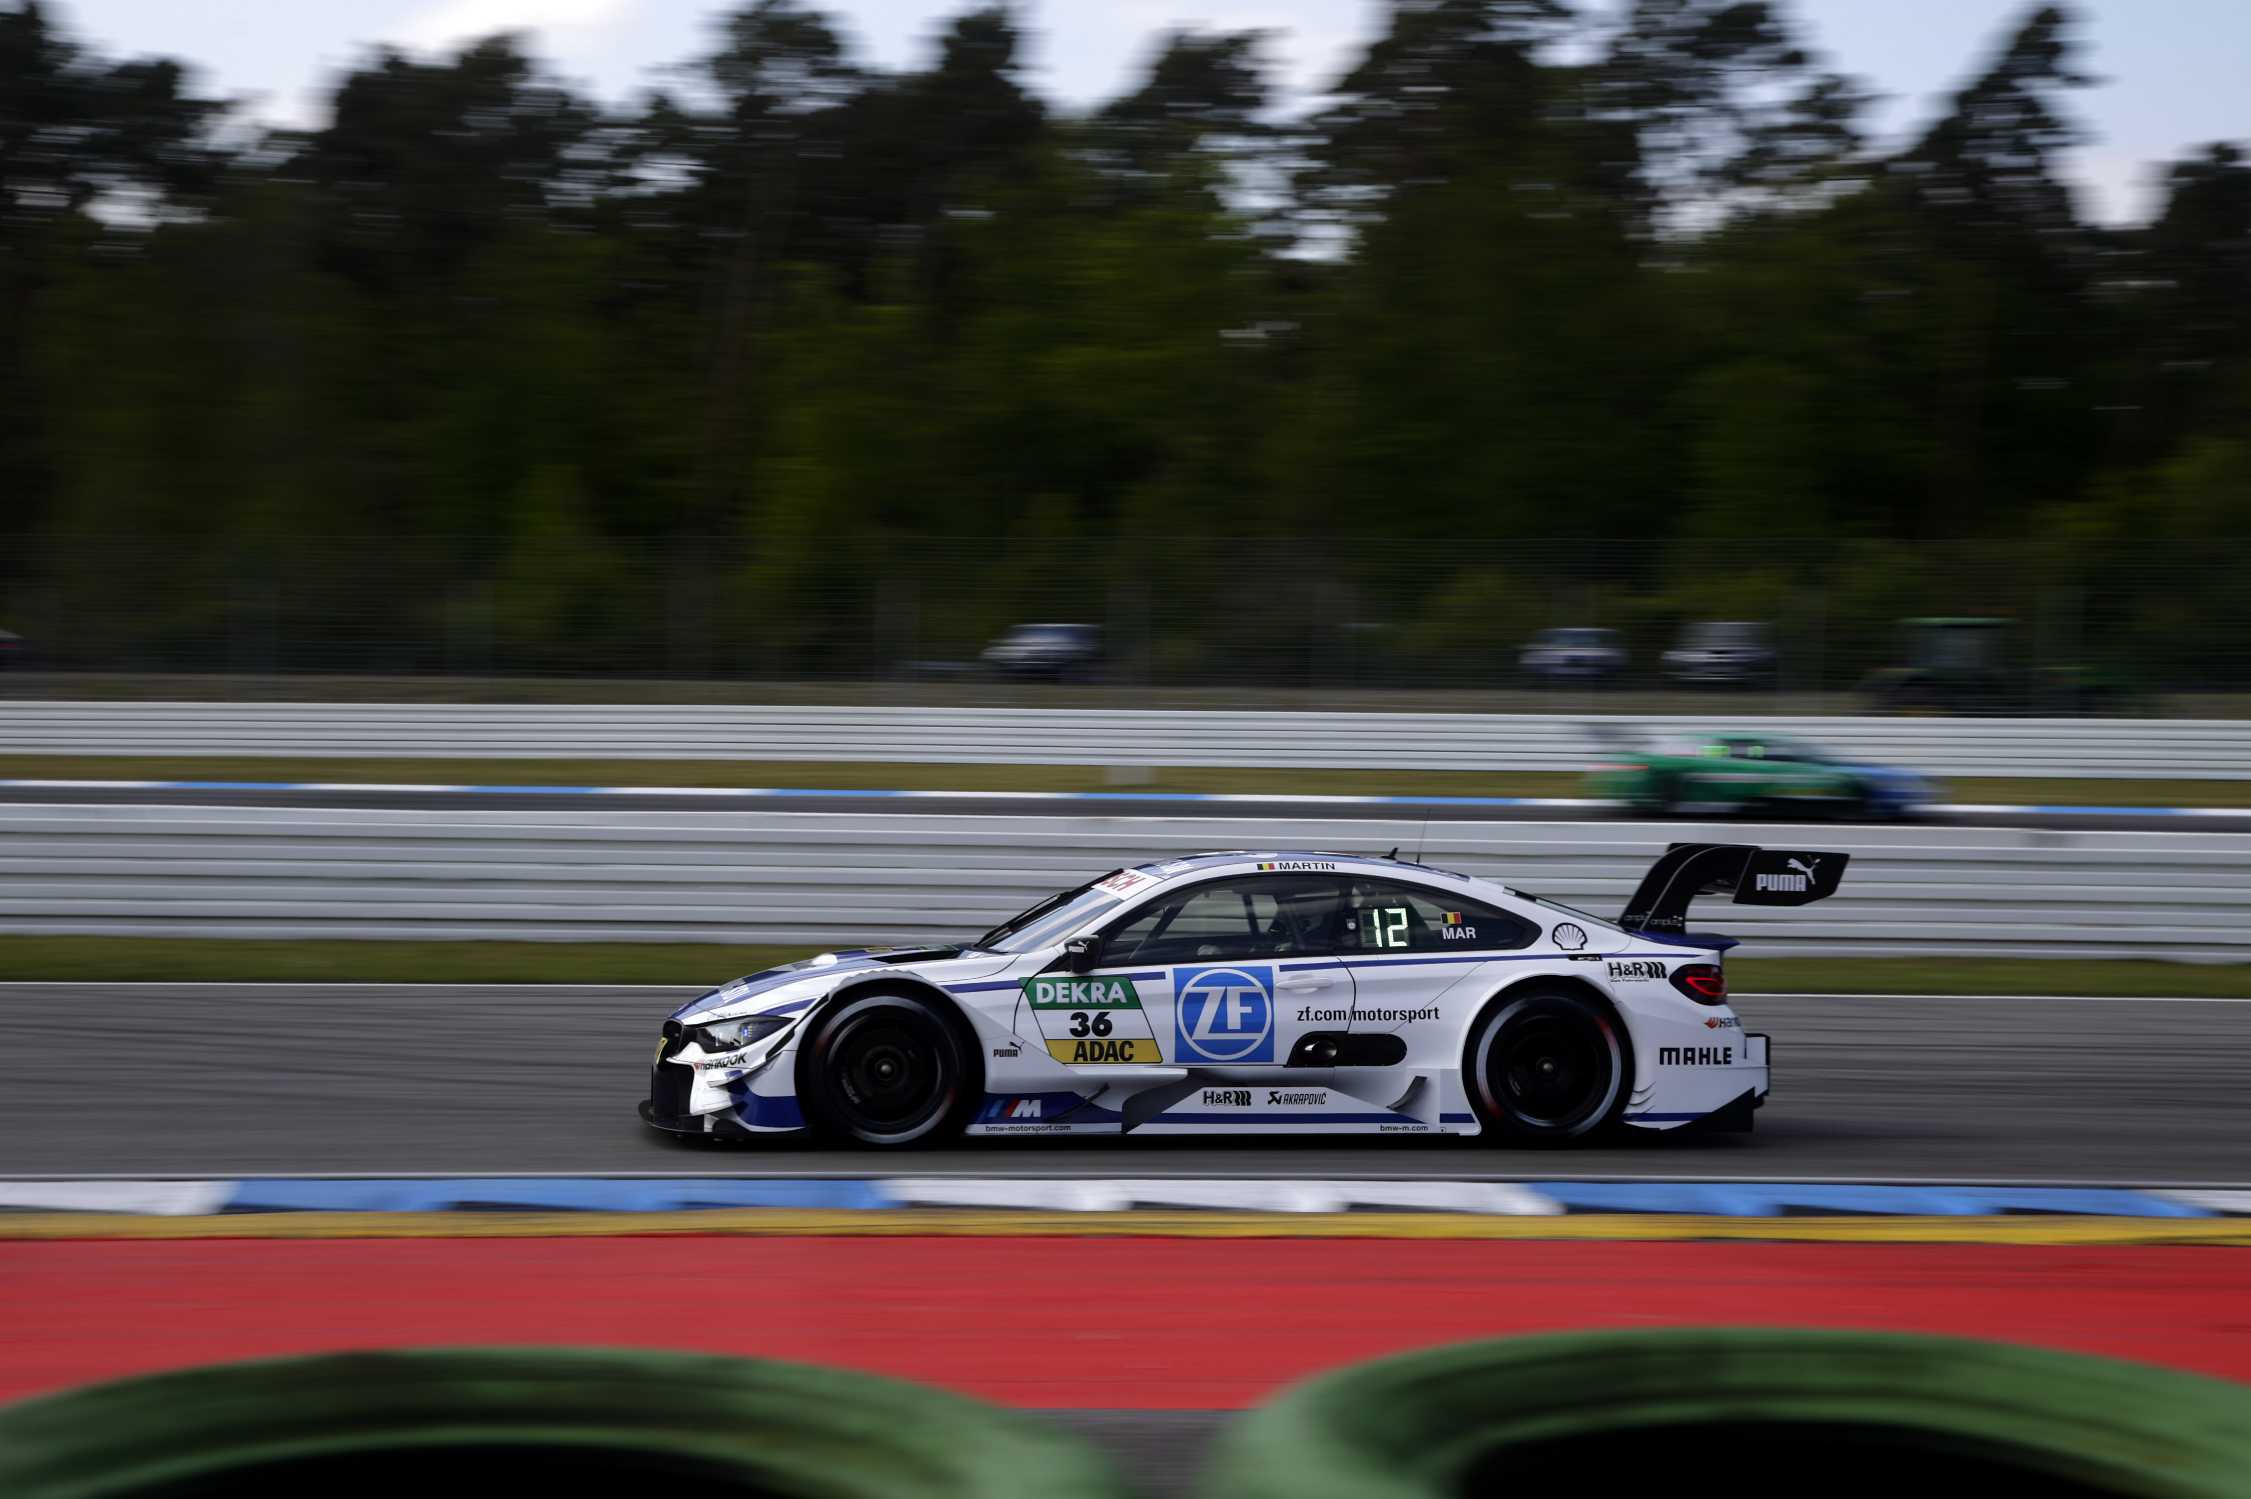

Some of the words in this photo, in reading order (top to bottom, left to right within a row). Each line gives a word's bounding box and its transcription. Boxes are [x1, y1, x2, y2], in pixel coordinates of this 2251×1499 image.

[1278, 862, 1336, 871] MARTIN
[1755, 873, 1807, 892] PUMA
[1372, 907, 1409, 948] 12
[1442, 927, 1477, 941] MAR
[1608, 961, 1645, 977] H&R
[1035, 982, 1127, 1004] DEKRA
[1184, 986, 1264, 1040] ZF
[1069, 1011, 1113, 1038] 36
[993, 1048, 1018, 1057] PUMA
[1073, 1040, 1134, 1062] ADAC
[1659, 1047, 1732, 1065] MAHLE
[1202, 1091, 1233, 1105] H&R
[1011, 1099, 1041, 1118] M
[985, 1125, 1071, 1134] bmw-motorsport.com
